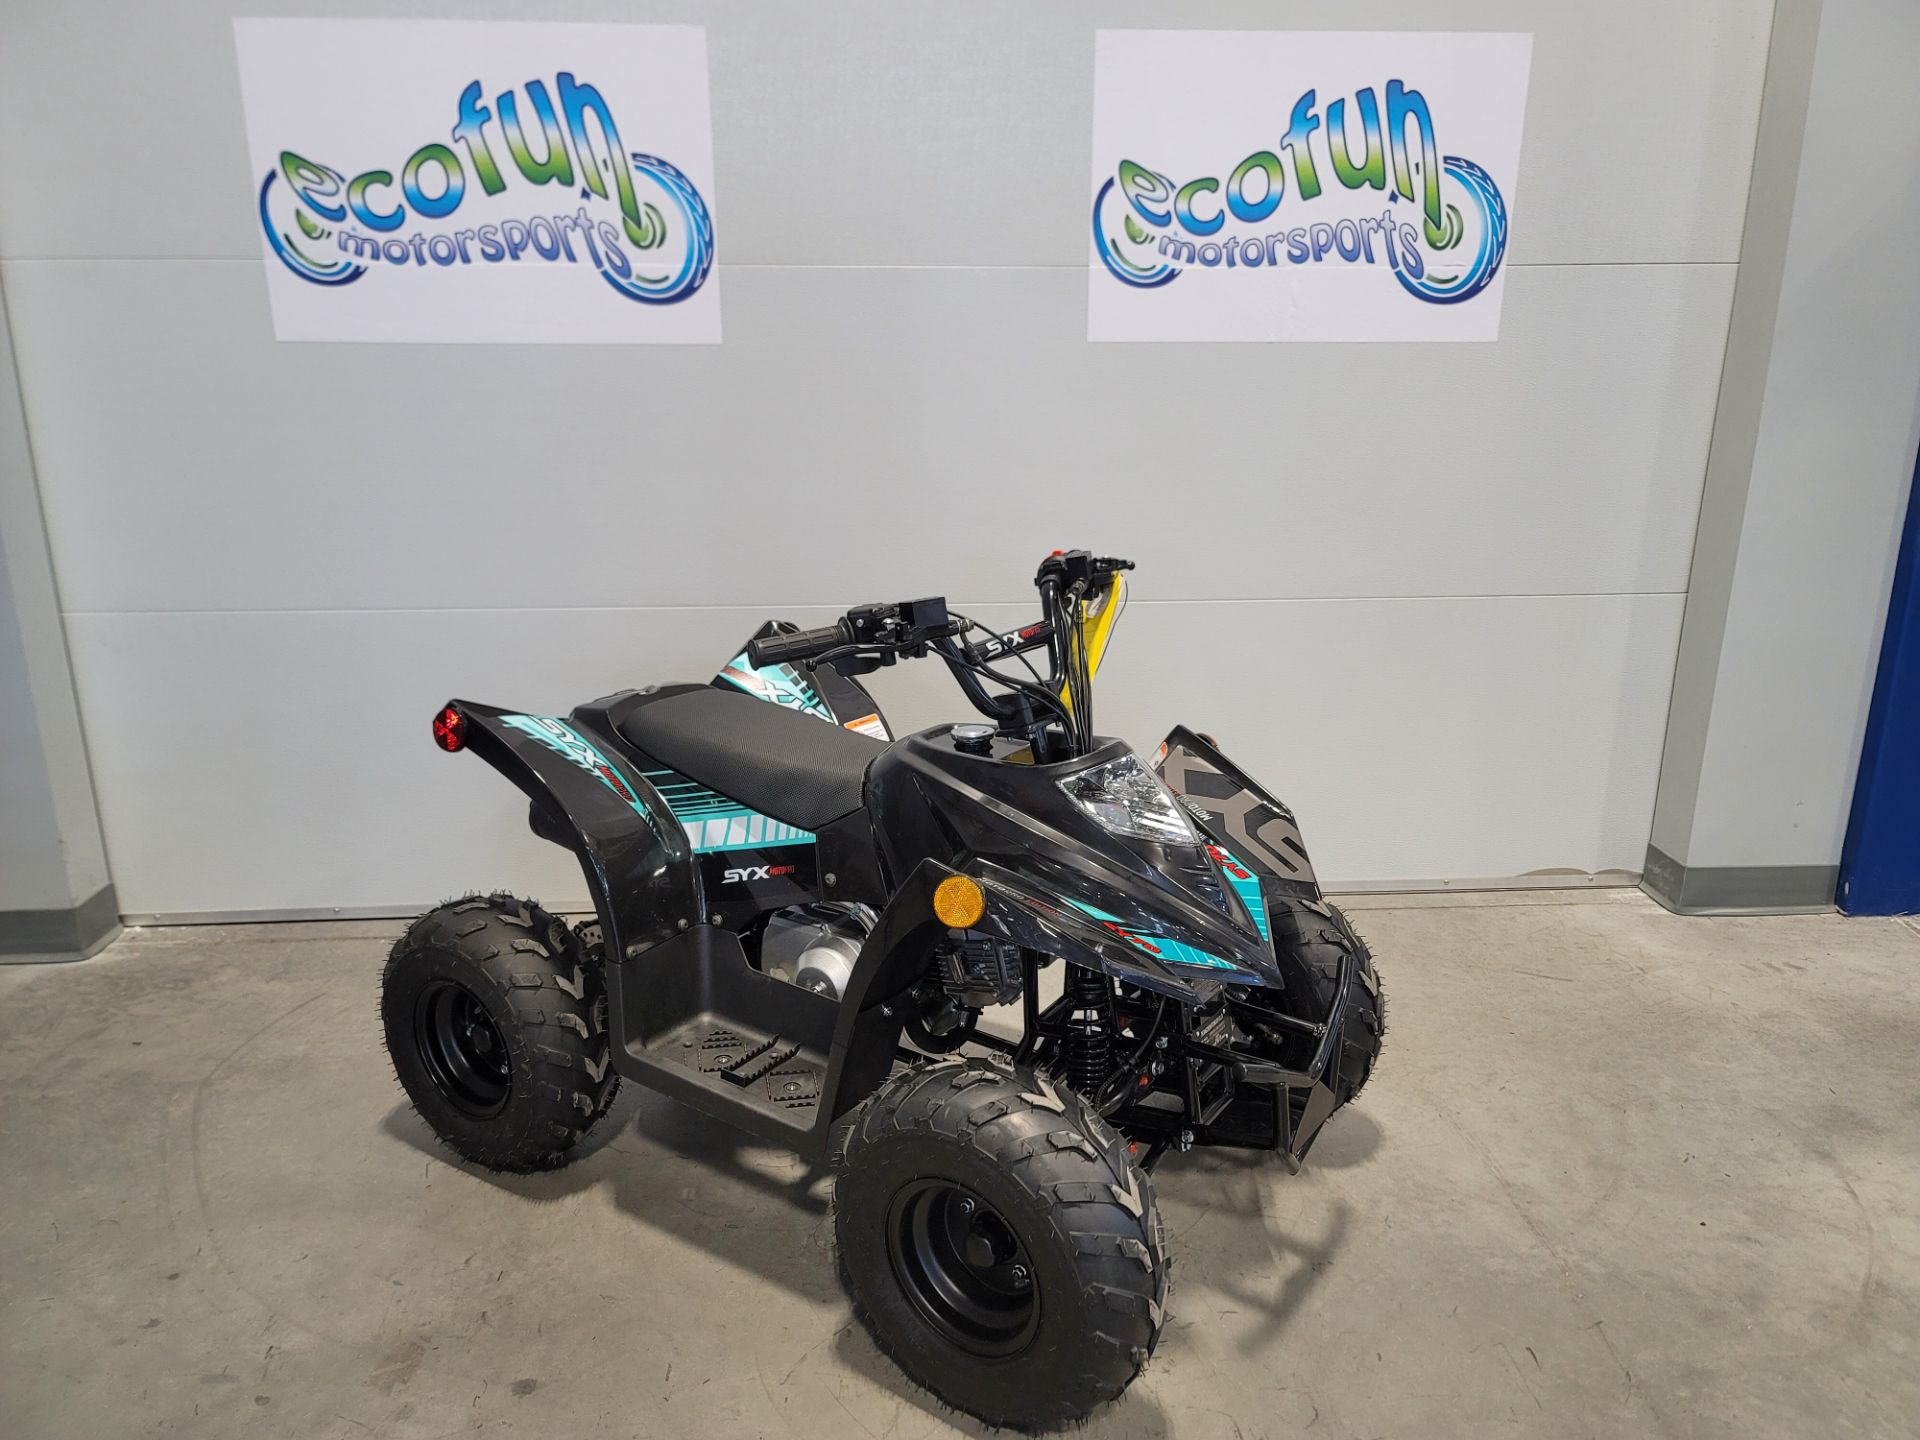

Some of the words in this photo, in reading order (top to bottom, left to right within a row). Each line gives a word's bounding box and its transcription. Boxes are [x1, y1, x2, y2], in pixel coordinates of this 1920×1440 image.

[338, 207, 632, 280] motorsports
[1157, 210, 1424, 280] motorsports
[540, 717, 609, 769] SYX
[721, 865, 770, 884] SYX
